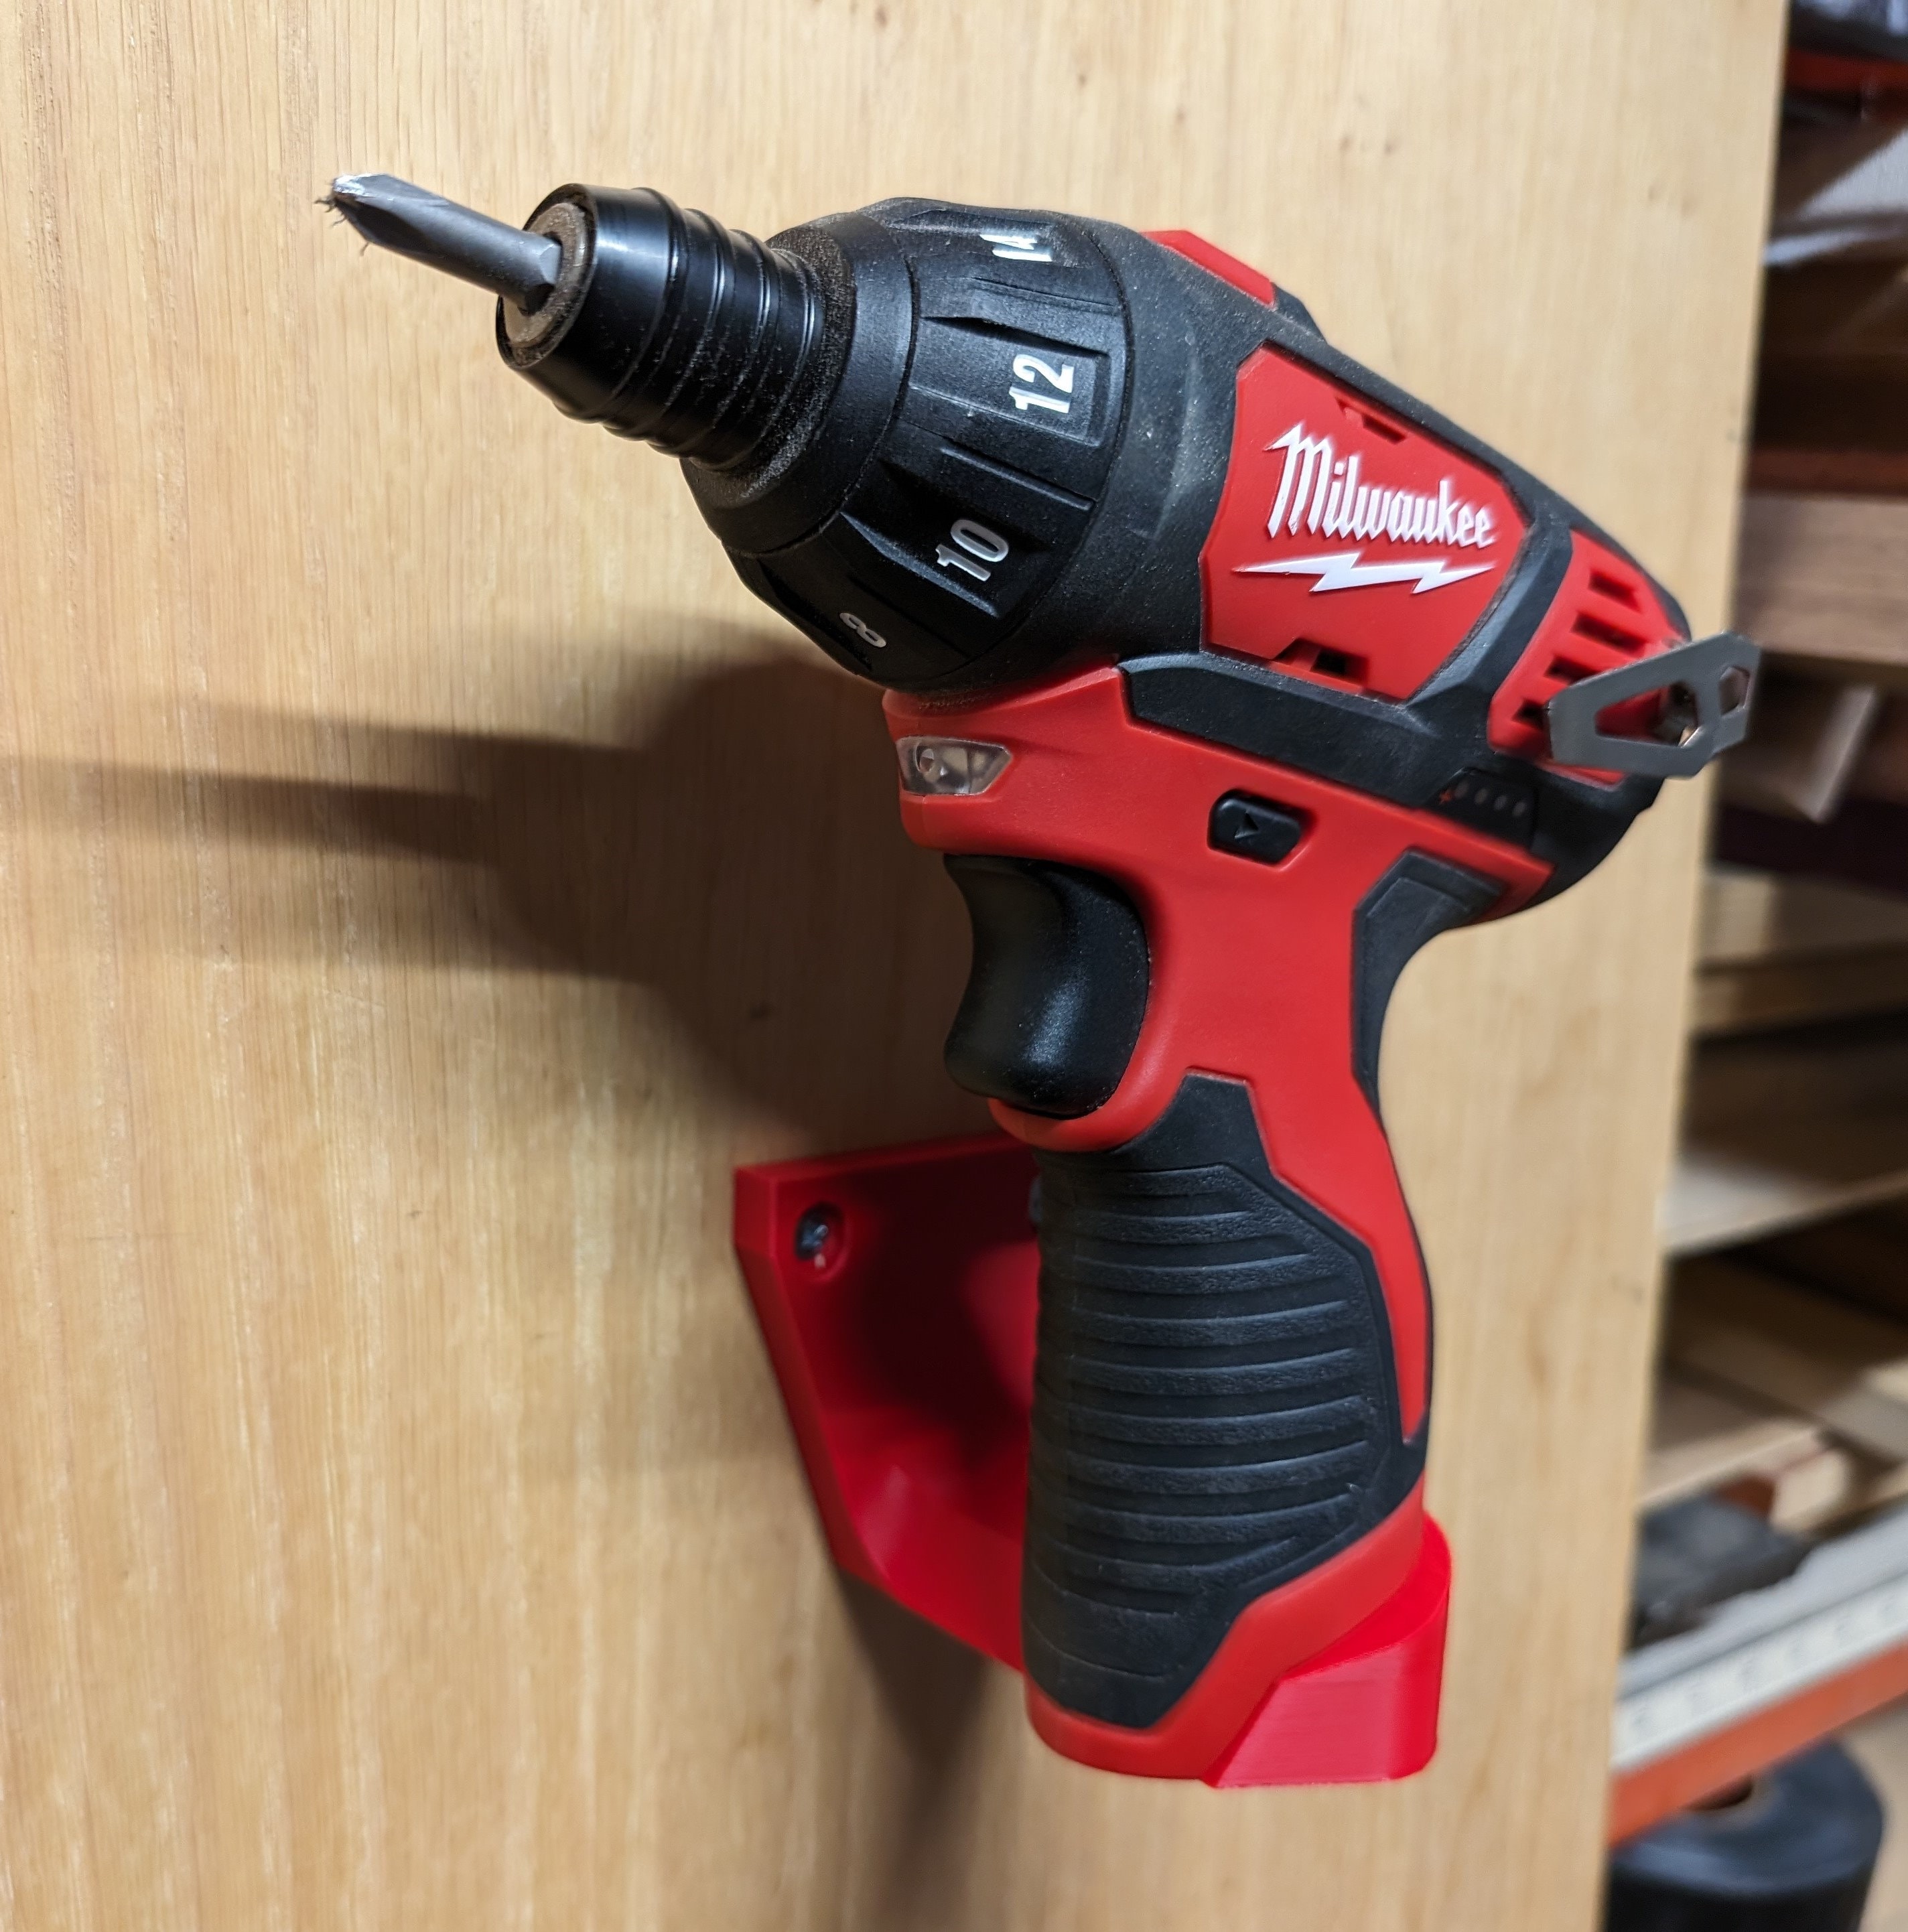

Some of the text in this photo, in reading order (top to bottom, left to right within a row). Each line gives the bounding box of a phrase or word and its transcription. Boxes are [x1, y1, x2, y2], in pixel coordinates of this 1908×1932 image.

[979, 233, 1054, 263] 14
[1009, 353, 1073, 415] 12
[1264, 423, 1497, 549] Milwaukee
[935, 519, 1010, 582] 10
[839, 612, 887, 648] 8
